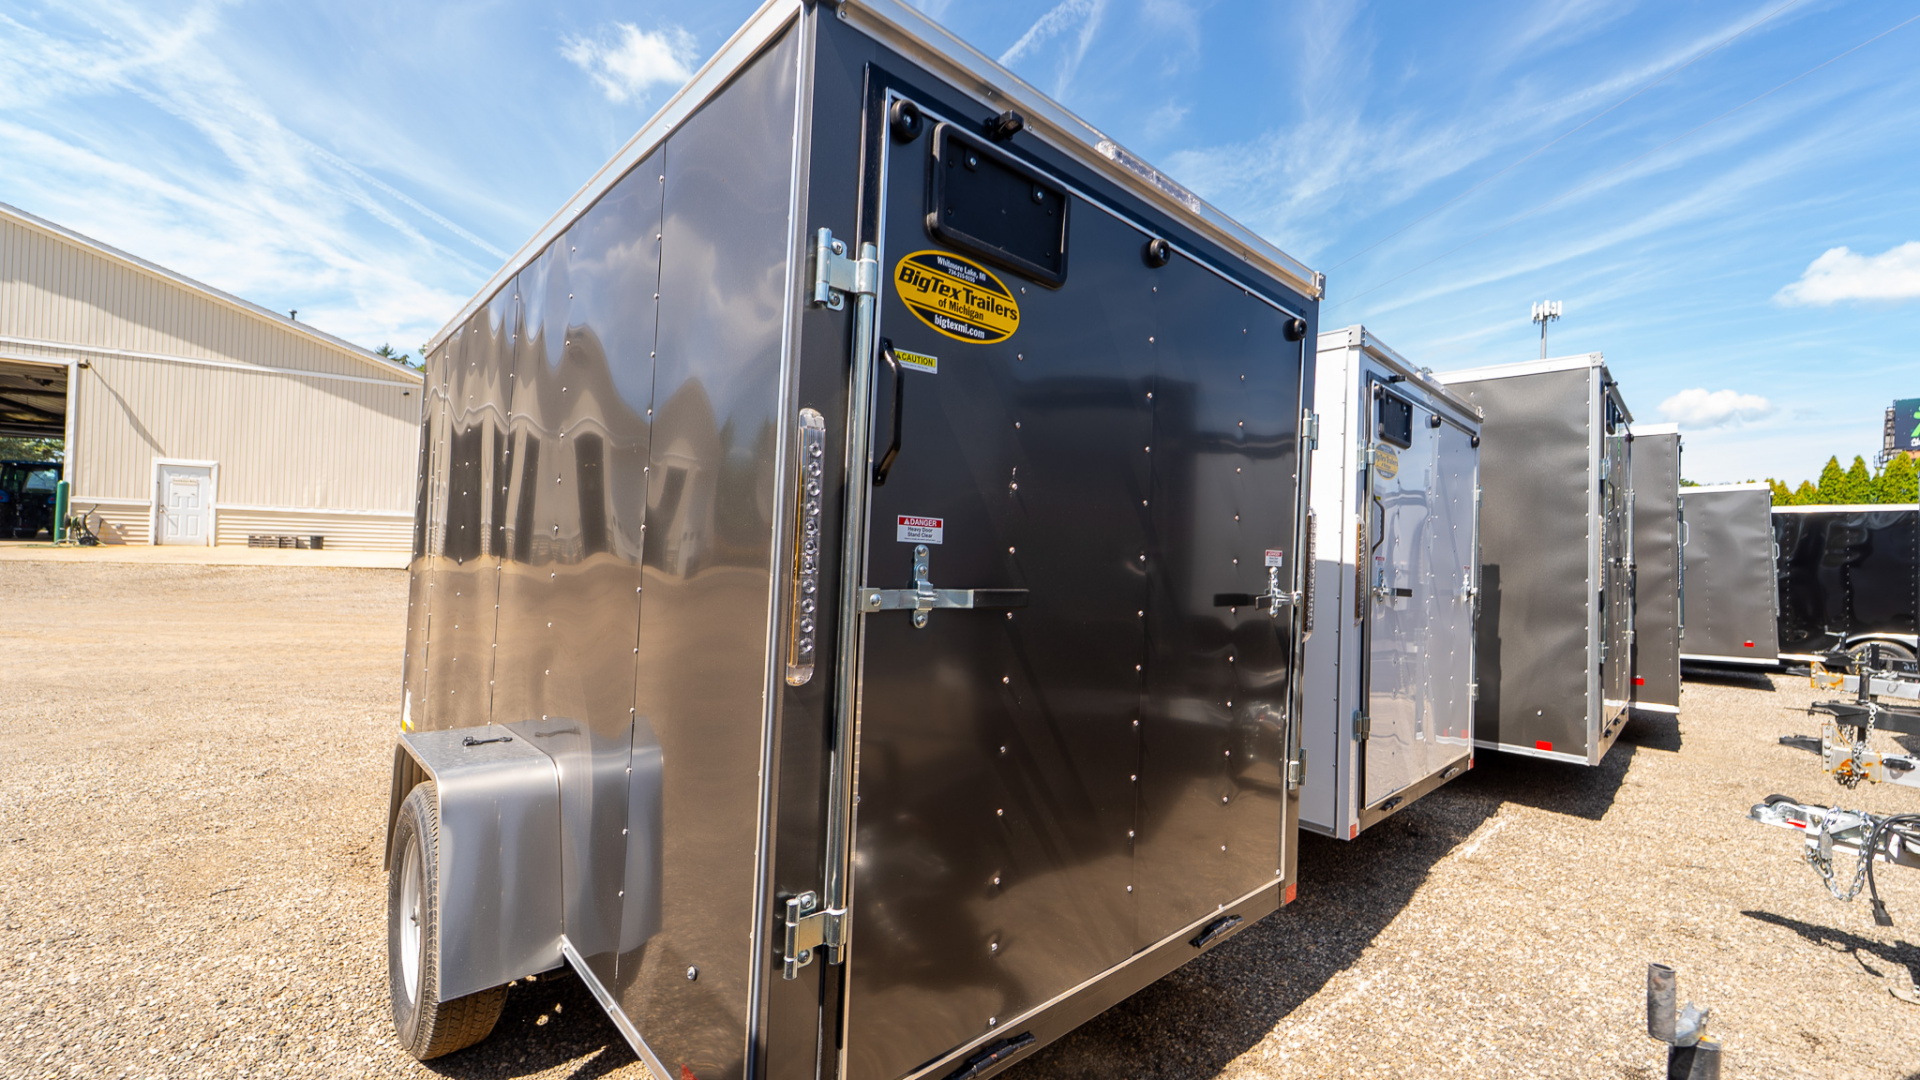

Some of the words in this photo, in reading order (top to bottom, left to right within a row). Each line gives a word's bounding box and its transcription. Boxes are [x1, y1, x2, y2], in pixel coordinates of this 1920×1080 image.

[937, 256, 964, 272] Whitmore
[964, 266, 979, 280] Lake,
[938, 298, 947, 308] of
[949, 301, 984, 321] Michigan
[962, 287, 1018, 321] Trailers
[934, 314, 985, 339] bigtexmi.com
[902, 353, 933, 367] CAUTION
[910, 518, 937, 527] DANGER
